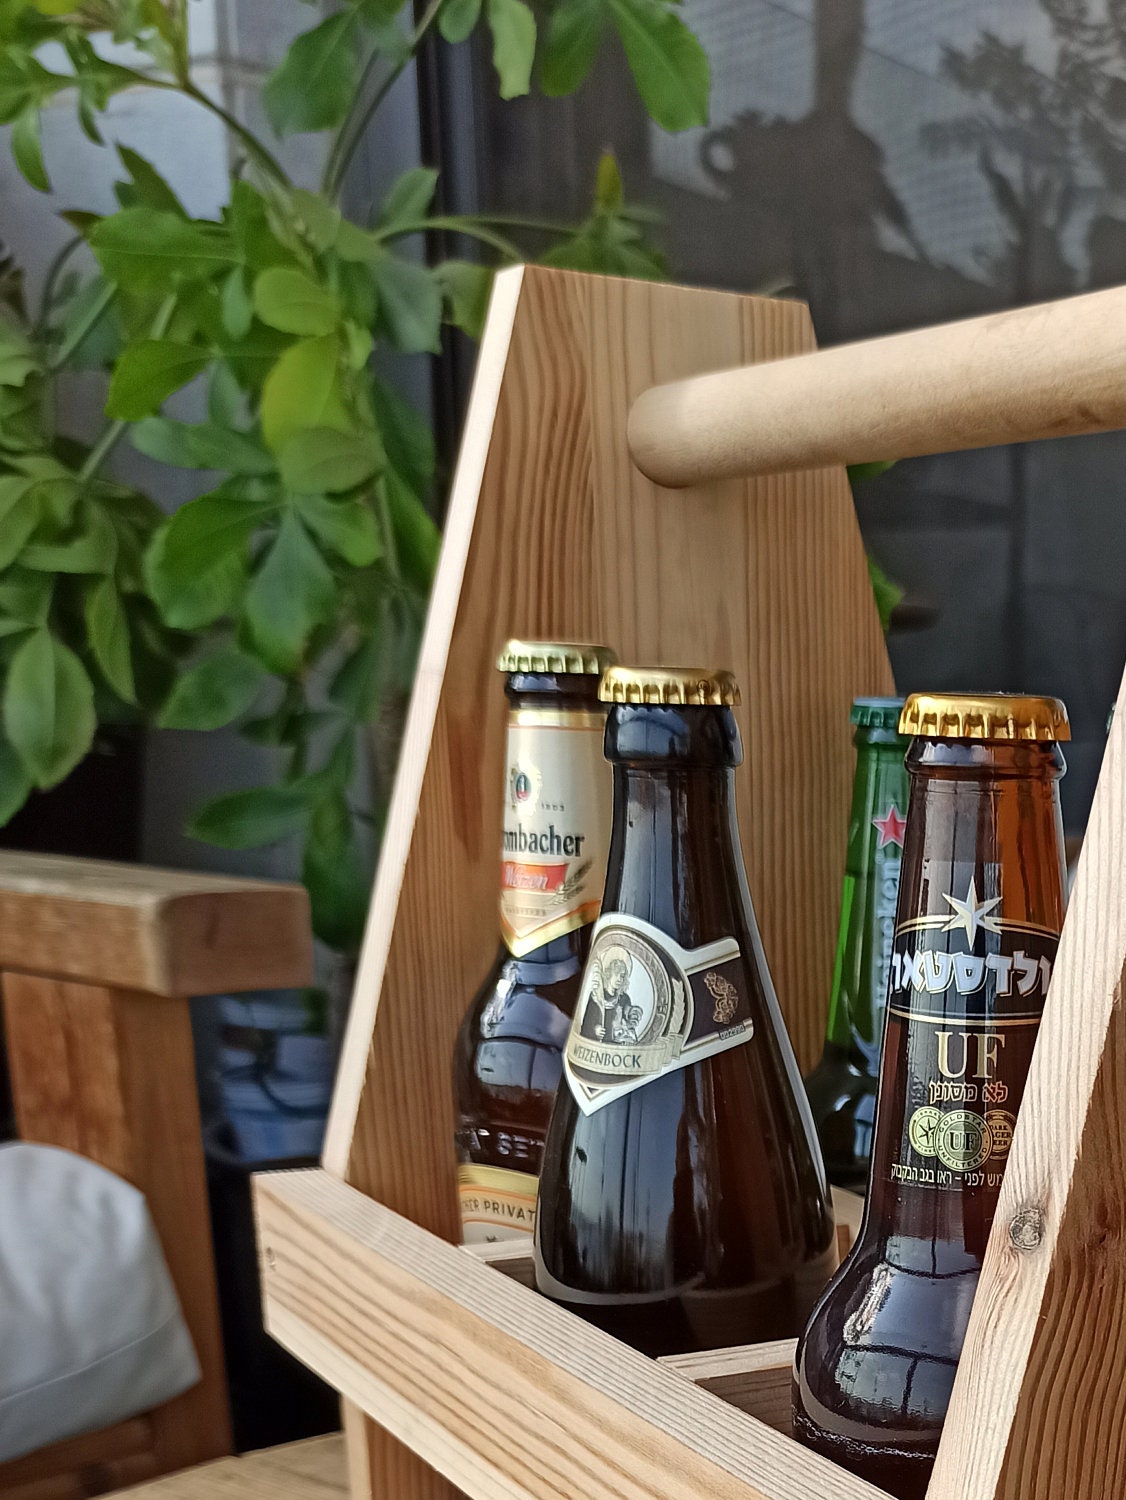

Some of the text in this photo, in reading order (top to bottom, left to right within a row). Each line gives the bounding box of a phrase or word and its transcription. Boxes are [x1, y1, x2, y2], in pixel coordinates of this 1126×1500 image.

[503, 823, 585, 857] ombacher
[891, 950, 1052, 997] ולדסטאר
[573, 1044, 642, 1069] WEIZENBOCK
[935, 1031, 1006, 1079] UF
[929, 1080, 978, 1104] מסונן
[982, 1081, 1008, 1103] לא
[939, 1113, 987, 1134] GOLDSTAR
[949, 1131, 977, 1151] UF
[938, 1145, 987, 1168] UNFILTERED
[484, 1200, 537, 1221] PRIVAT
